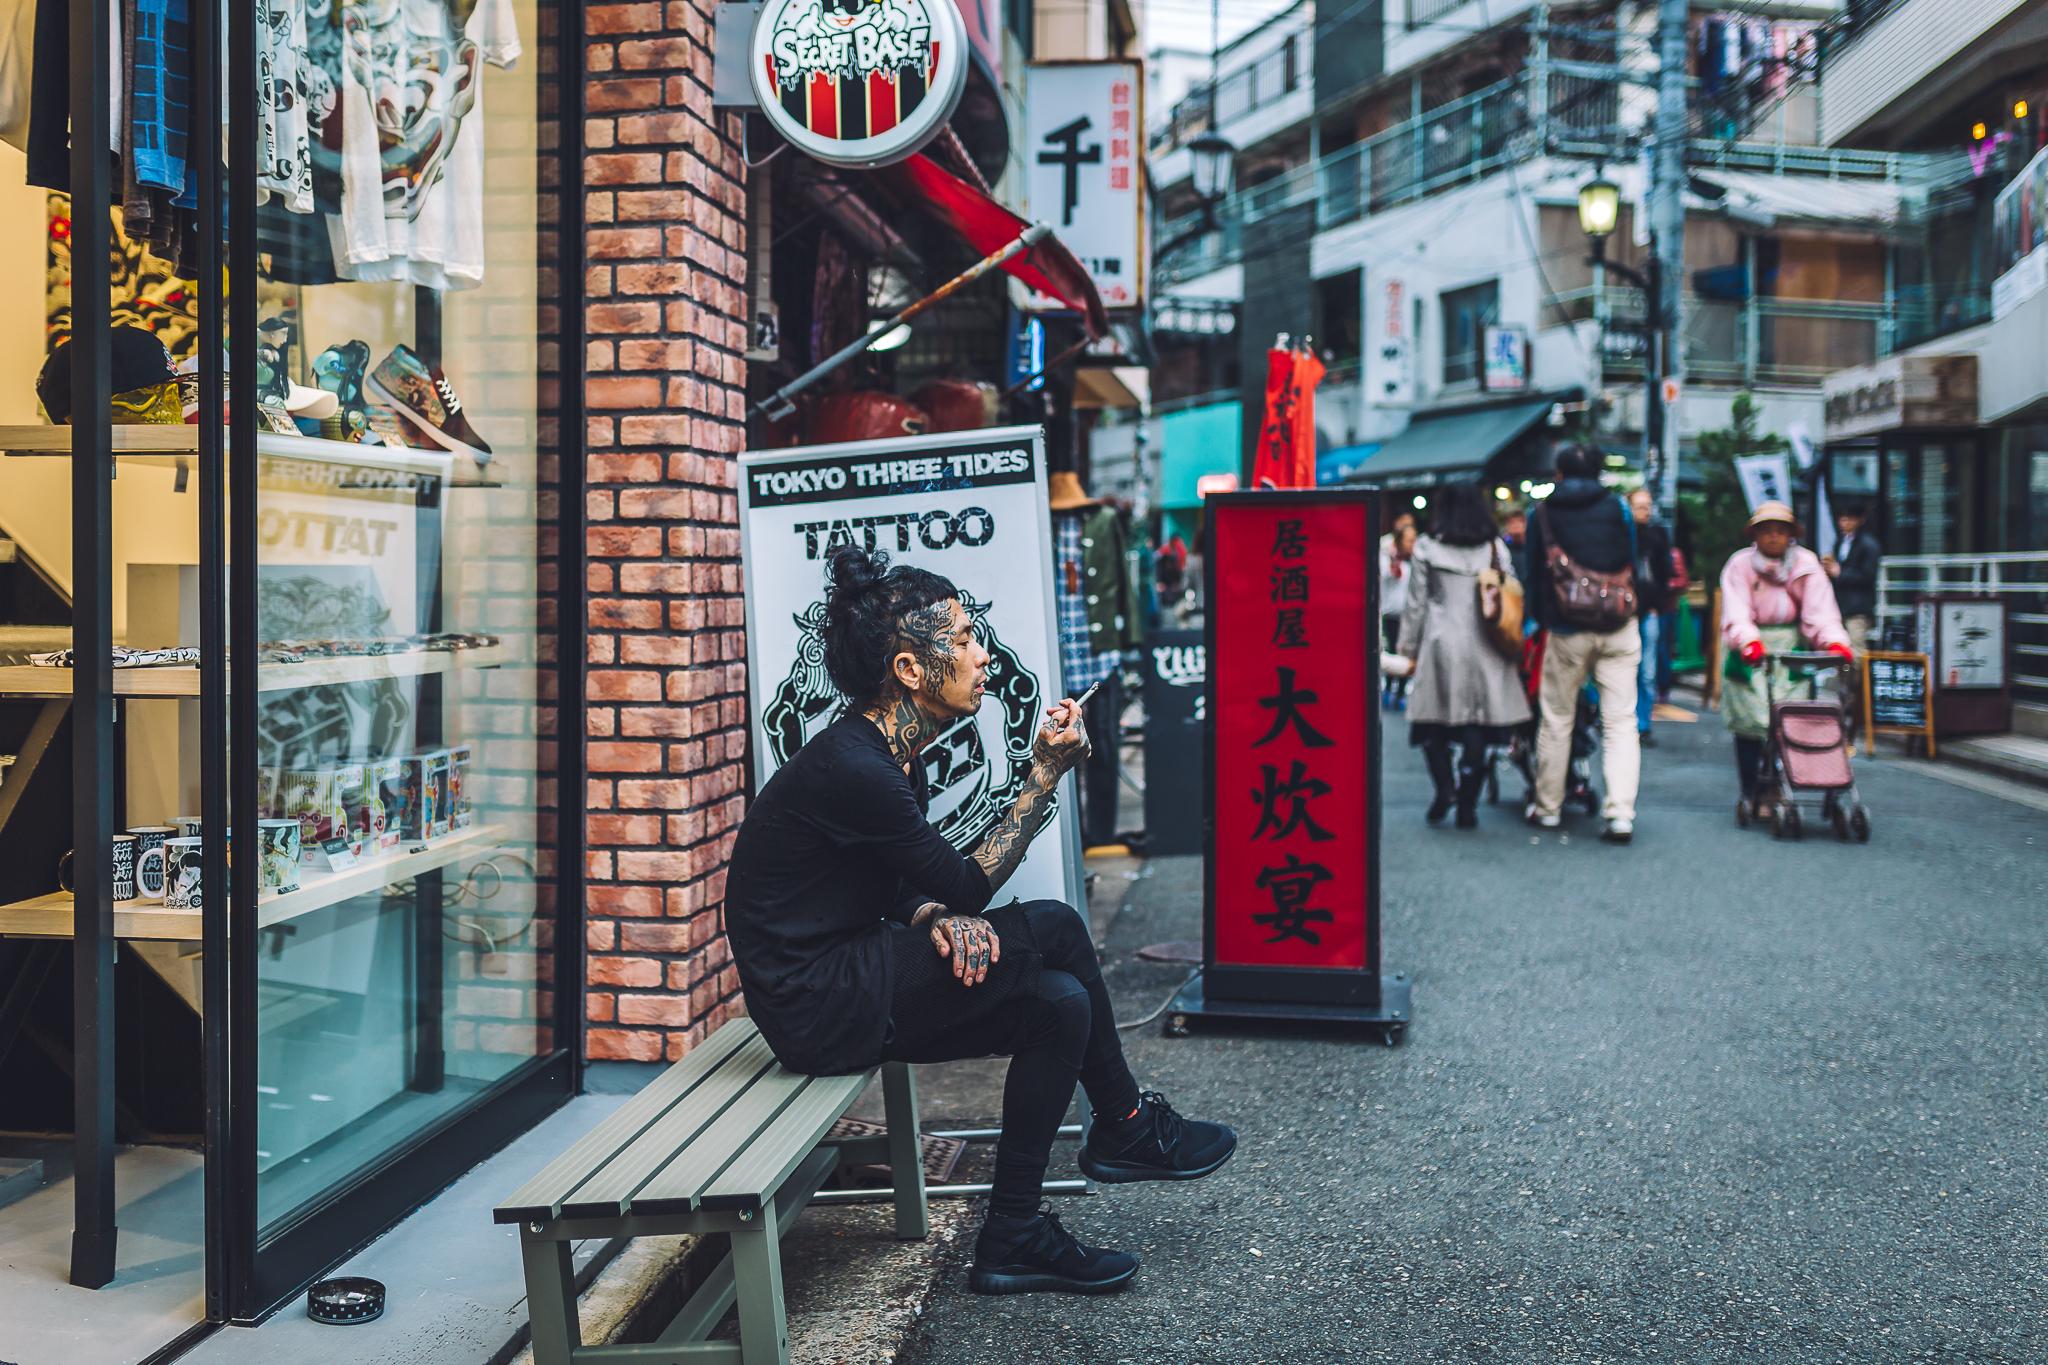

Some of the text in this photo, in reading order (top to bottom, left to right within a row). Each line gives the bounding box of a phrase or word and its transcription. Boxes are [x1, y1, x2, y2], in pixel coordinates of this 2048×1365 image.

[773, 23, 931, 78] SECRET BASE
[1036, 114, 1102, 227] 千
[753, 466, 847, 497] TOKYO
[850, 456, 943, 487] THREE
[947, 449, 1030, 478] TIDES
[793, 506, 995, 561] TATTOO
[1271, 519, 1310, 650] 居酒屋
[1250, 666, 1337, 946] 大炊宴
